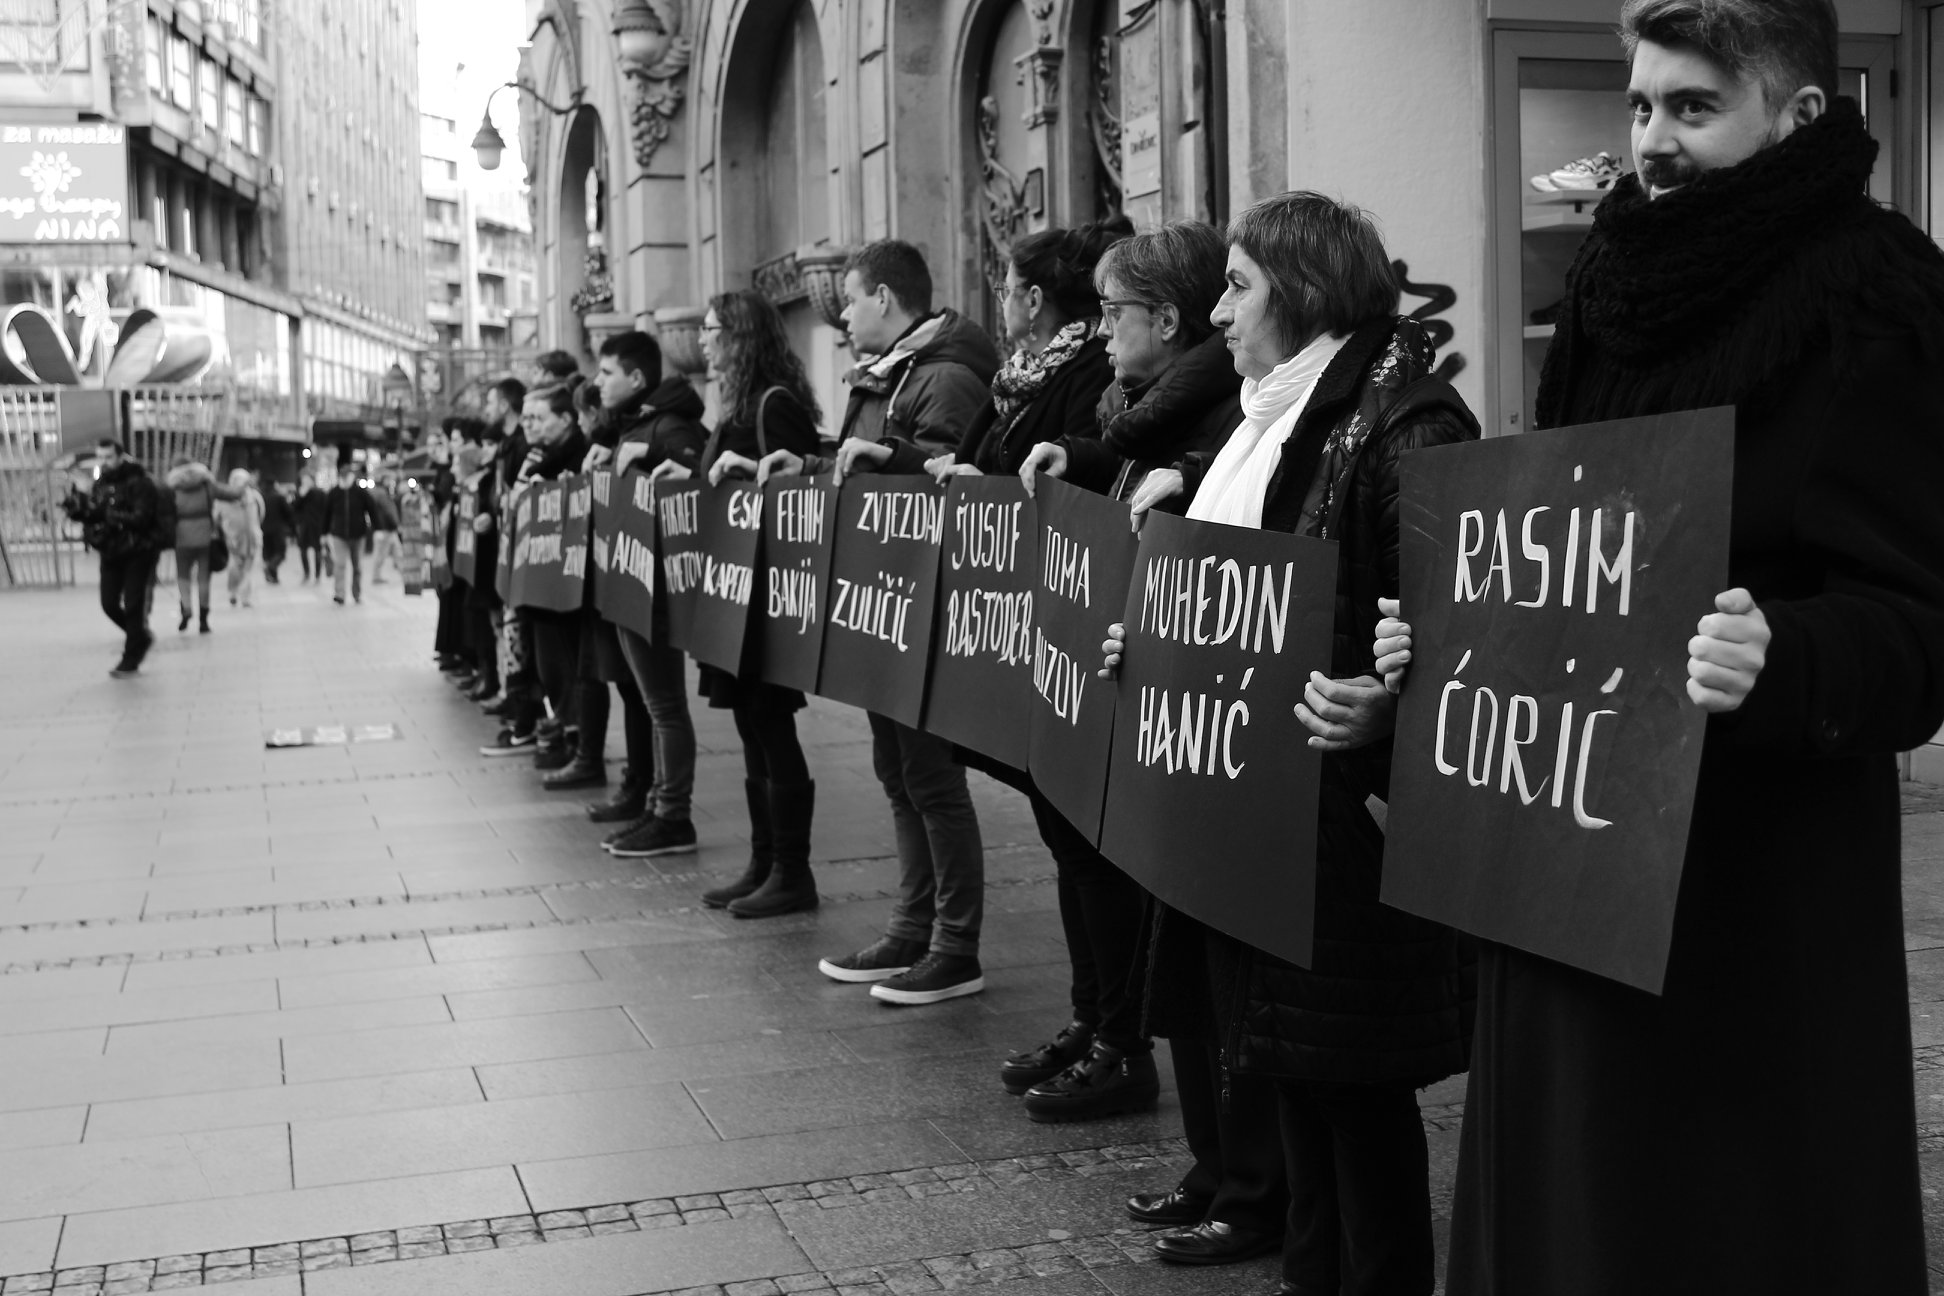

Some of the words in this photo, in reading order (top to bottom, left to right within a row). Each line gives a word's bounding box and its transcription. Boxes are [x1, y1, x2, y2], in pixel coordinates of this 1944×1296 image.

[35, 218, 120, 240] NINA
[660, 490, 700, 537] FIKRET
[776, 476, 825, 545] FEHIM
[952, 492, 1022, 573] JUSUF
[1454, 465, 1635, 616] RASIM
[767, 558, 817, 635] BAKIJA
[1044, 525, 1091, 608] TOMA
[1140, 555, 1294, 655] MUHEDIN
[830, 570, 916, 653] ZULIČIĆ
[946, 588, 1033, 667] RASTODER
[1137, 667, 1255, 780] HANIĆ
[1433, 648, 1624, 830] ĆORIĆ
